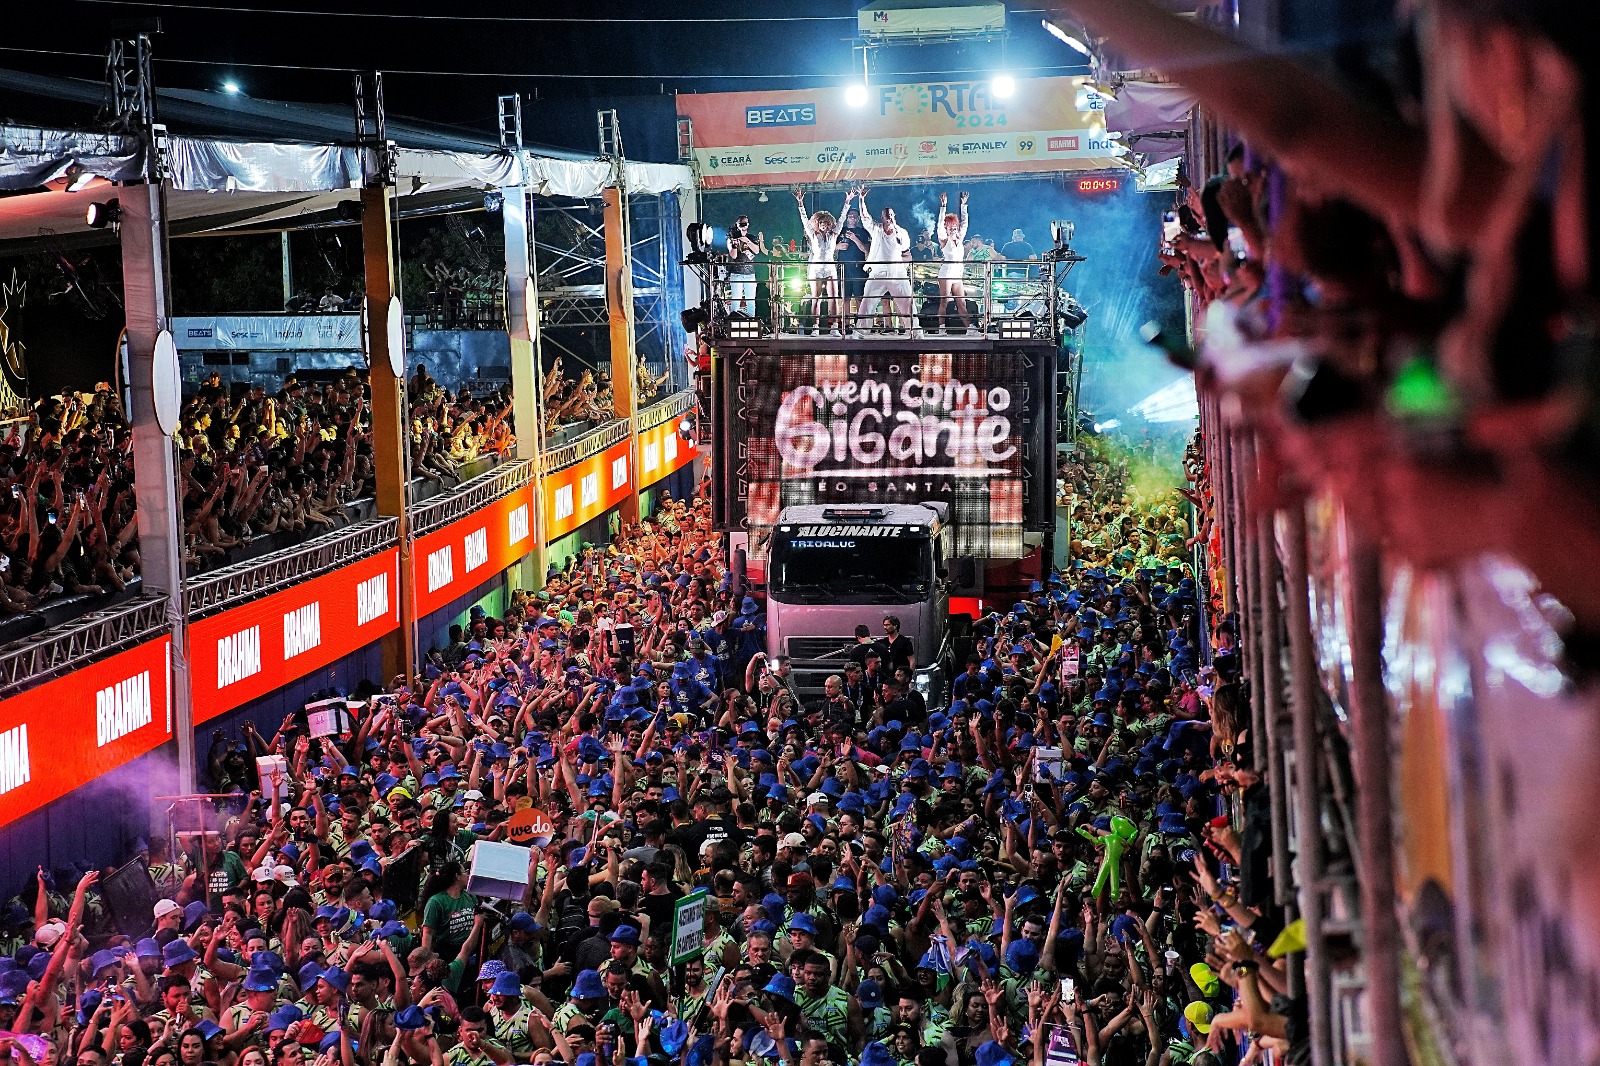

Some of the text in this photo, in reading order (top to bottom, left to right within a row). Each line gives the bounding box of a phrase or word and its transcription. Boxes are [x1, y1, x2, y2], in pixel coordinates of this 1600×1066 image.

[873, 11, 889, 23] M4
[747, 107, 814, 124] BEATS
[955, 114, 1008, 128] 2024
[962, 141, 1008, 152] STANLEY
[1019, 140, 1034, 151] 99
[1050, 139, 1076, 149] BRAHMA
[865, 147, 892, 156] smart
[720, 154, 752, 164] CEARÁ
[764, 156, 788, 165] Sesc
[188, 329, 212, 337] BEATS
[823, 379, 893, 417] vem
[797, 525, 904, 538] ALUCINANTE
[357, 572, 389, 627] BRAHMA
[283, 601, 321, 661] BRAHMA
[217, 625, 262, 690] BRAHMA
[96, 670, 152, 748] BRAHMA
[511, 815, 551, 837] wedo
